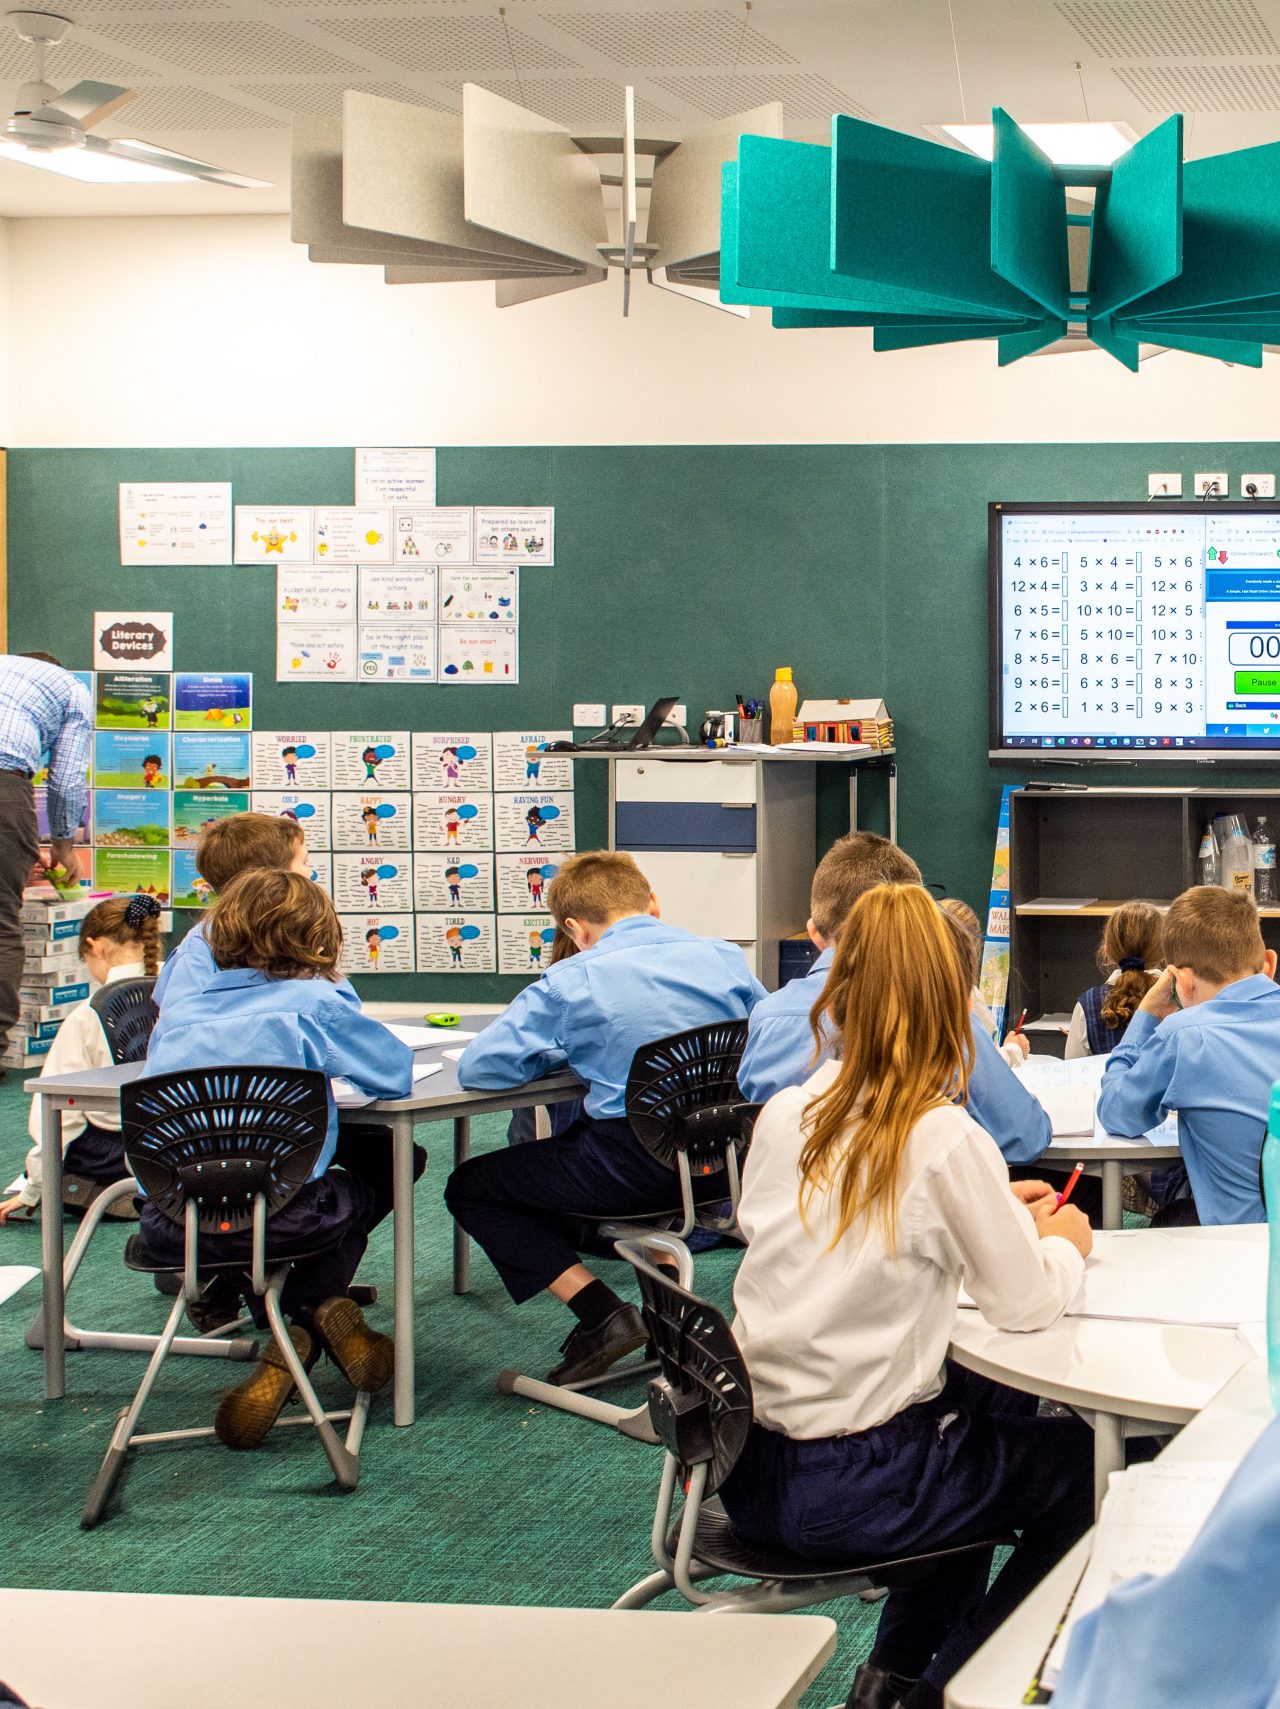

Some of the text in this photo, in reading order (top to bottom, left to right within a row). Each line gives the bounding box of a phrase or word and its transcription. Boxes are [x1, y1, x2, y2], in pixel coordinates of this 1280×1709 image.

[1014, 557, 1021, 567] 4
[1041, 557, 1048, 568] 6
[1081, 557, 1087, 568] 5
[1111, 557, 1117, 567] 4
[1155, 557, 1161, 567] 5
[1185, 557, 1192, 567] 6
[1012, 581, 1025, 592] 12
[1041, 581, 1047, 591] 4
[1081, 581, 1087, 592] 3
[1111, 581, 1117, 591] 4
[1152, 581, 1165, 591] 12
[1185, 581, 1192, 592] 6
[1015, 605, 1021, 616] 6
[1041, 605, 1048, 616] 5
[1078, 605, 1091, 616] 10
[1108, 605, 1122, 616] 10
[1152, 605, 1165, 616] 12
[1186, 605, 1192, 616] 5
[112, 631, 154, 640] Literary
[1015, 630, 1022, 640] 7
[1041, 629, 1048, 640] 6
[1081, 630, 1088, 640] 5
[1108, 629, 1122, 640] 10
[1152, 630, 1166, 640] 10
[1186, 630, 1192, 640] 3
[112, 641, 153, 650] Devices
[1015, 653, 1022, 664] 8
[1042, 654, 1048, 664] 5
[1081, 654, 1088, 664] 8
[1111, 654, 1118, 664] 6
[1155, 654, 1162, 664] 7
[1183, 654, 1196, 664] 10
[1015, 702, 1022, 712] 2
[1041, 702, 1048, 712] 6
[1082, 702, 1086, 712] 1
[1112, 702, 1118, 713] 3
[1155, 702, 1162, 713] 9
[1186, 702, 1192, 713] 3
[1001, 896, 1007, 905] 2
[992, 912, 1008, 920] WAL
[990, 924, 1009, 934] MAPS
